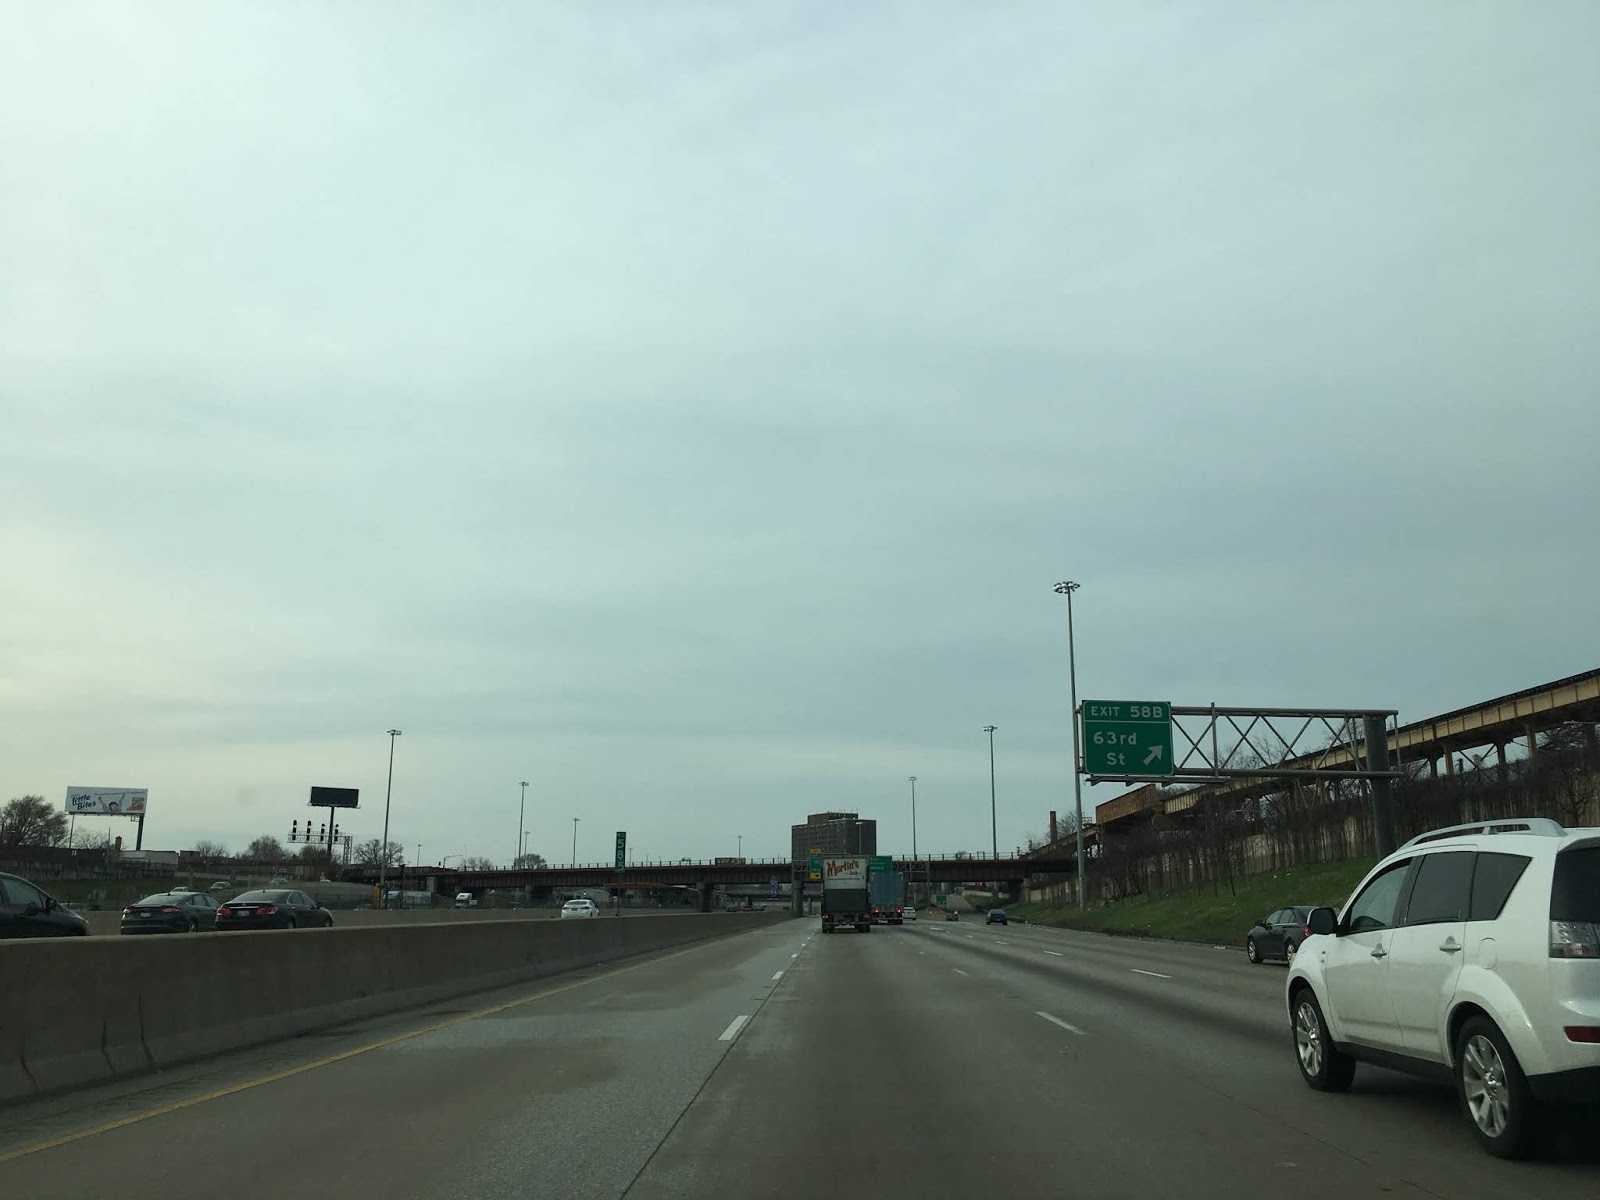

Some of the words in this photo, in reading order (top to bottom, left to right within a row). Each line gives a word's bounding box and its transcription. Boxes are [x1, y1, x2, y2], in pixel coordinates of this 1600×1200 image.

[1091, 706, 1120, 716] EXIT
[1130, 706, 1163, 718] 58B
[1093, 731, 1137, 745] 63rd
[1106, 752, 1125, 765] St
[72, 794, 91, 806] Little
[77, 800, 97, 811] Bites
[826, 859, 859, 878] Martin's
